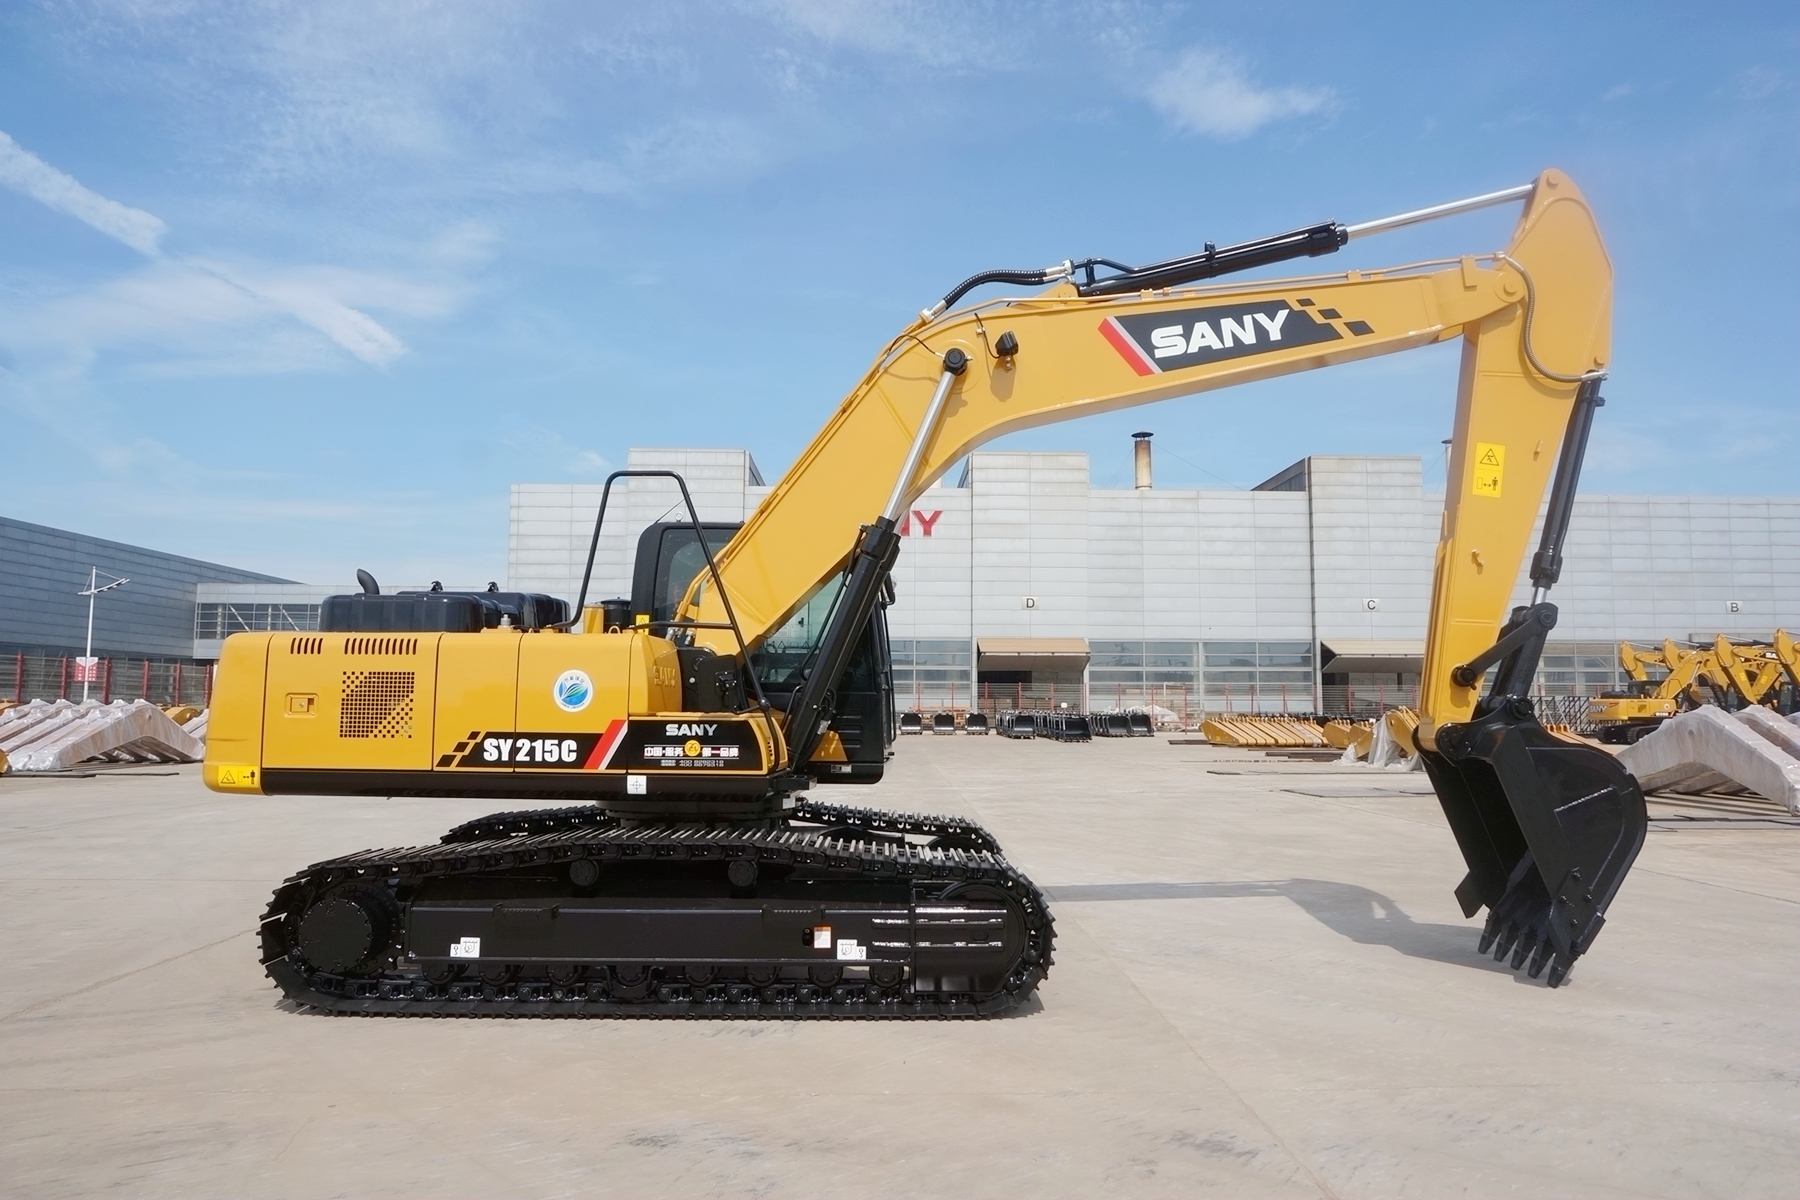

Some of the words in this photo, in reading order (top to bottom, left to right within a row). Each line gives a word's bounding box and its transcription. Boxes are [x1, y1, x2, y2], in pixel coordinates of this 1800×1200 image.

[1150, 308, 1290, 359] SANY
[1026, 597, 1035, 609] D
[1367, 599, 1376, 611] C
[1730, 602, 1739, 613] B
[665, 723, 718, 736] SANY
